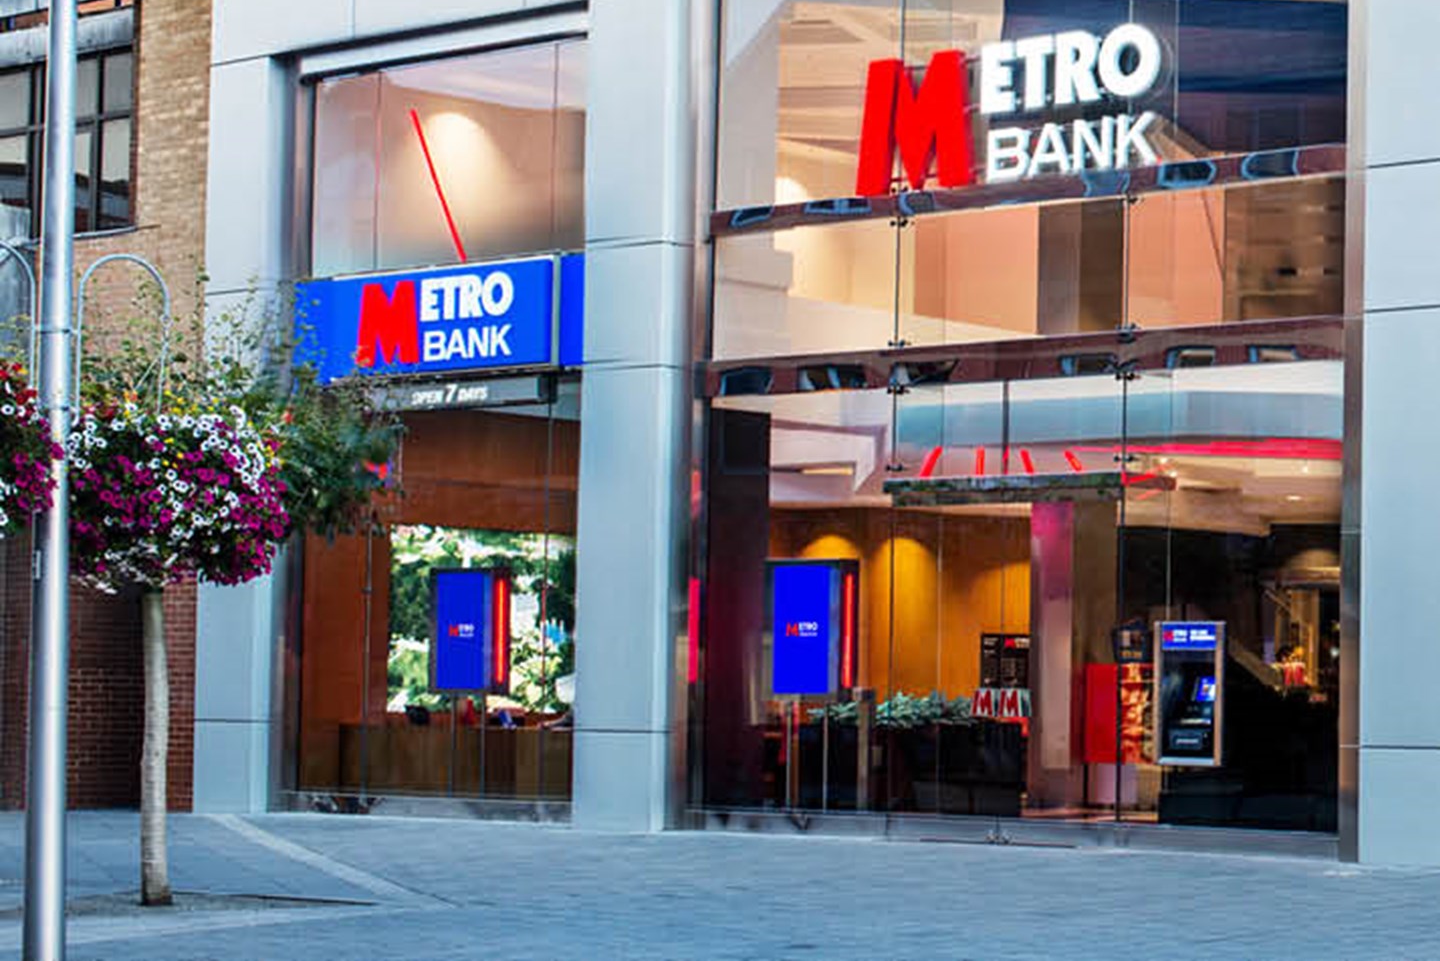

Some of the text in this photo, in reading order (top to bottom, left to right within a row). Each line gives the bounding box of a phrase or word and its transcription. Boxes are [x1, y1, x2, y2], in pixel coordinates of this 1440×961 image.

[856, 23, 1161, 196] METRO
[986, 111, 1164, 183] BANK
[355, 271, 514, 367] METRO
[423, 324, 512, 361] BANK
[411, 384, 488, 405] OPEN 7 DAYS
